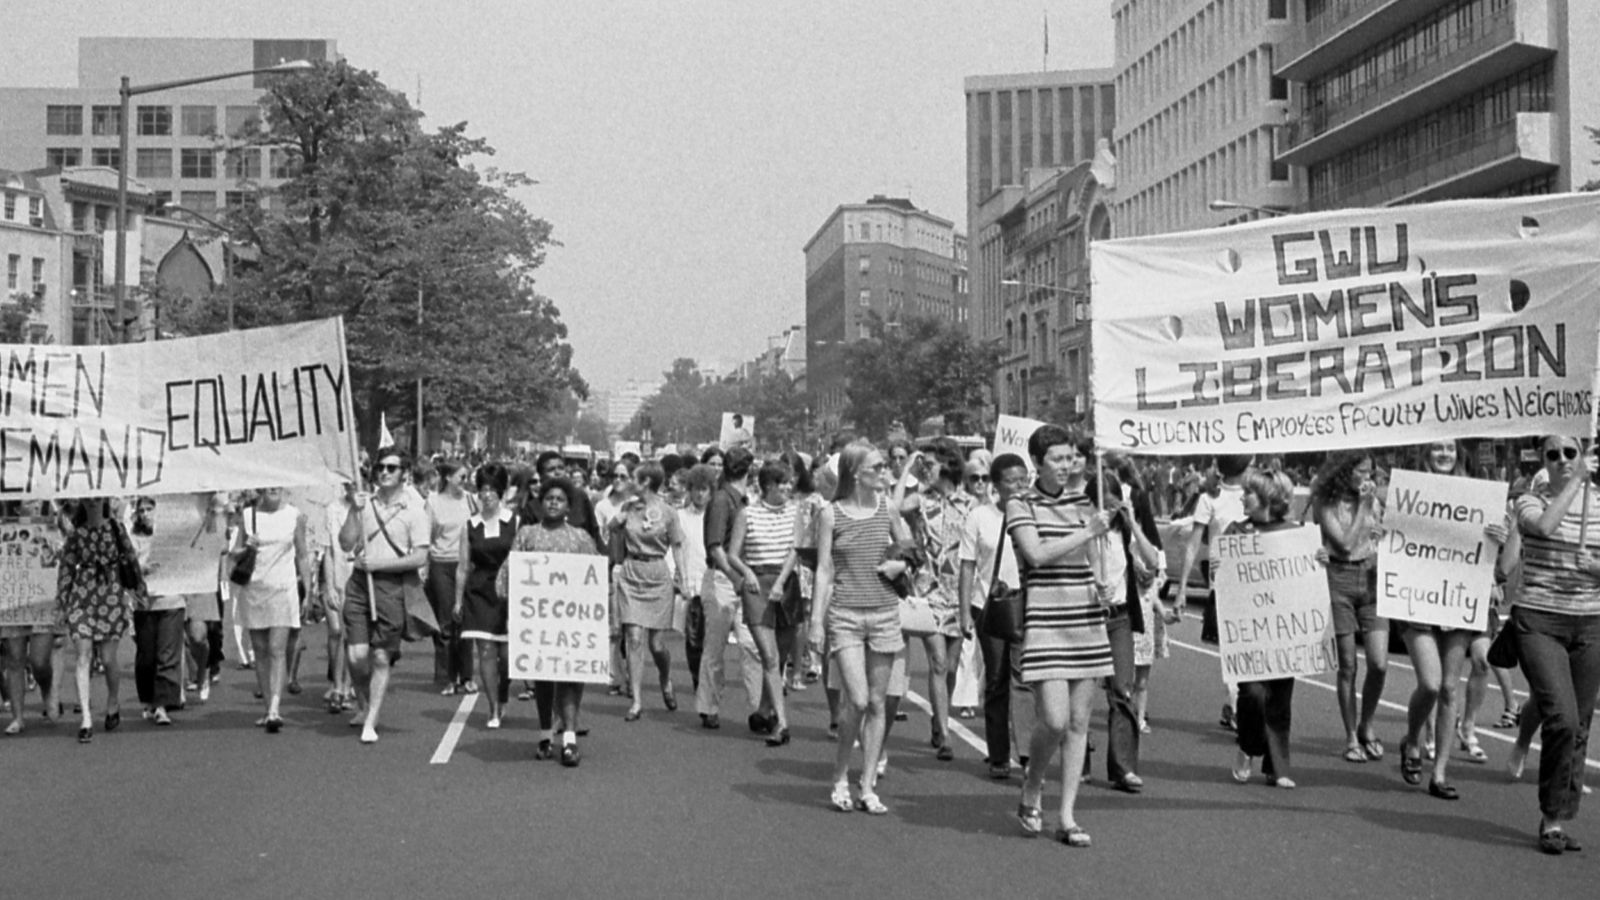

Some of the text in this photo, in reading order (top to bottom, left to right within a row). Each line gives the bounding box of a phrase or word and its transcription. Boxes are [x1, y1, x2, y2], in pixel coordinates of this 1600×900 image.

[1271, 222, 1408, 286] GWU
[1214, 271, 1480, 351] WOMEN'S
[0, 346, 106, 419] MEN
[1135, 322, 1567, 411] LIBERATION
[166, 363, 345, 456] EQUALITY
[1395, 487, 1485, 524] Women
[1217, 534, 1265, 558] FREE
[1389, 529, 1483, 566] Demand
[583, 563, 599, 586] A
[1236, 553, 1317, 584] ABORTION
[519, 596, 606, 621] SECOND
[1252, 591, 1276, 608] ON
[1384, 571, 1478, 624] Equality
[519, 628, 598, 649] CLASS
[1223, 608, 1325, 644] DEMAND
